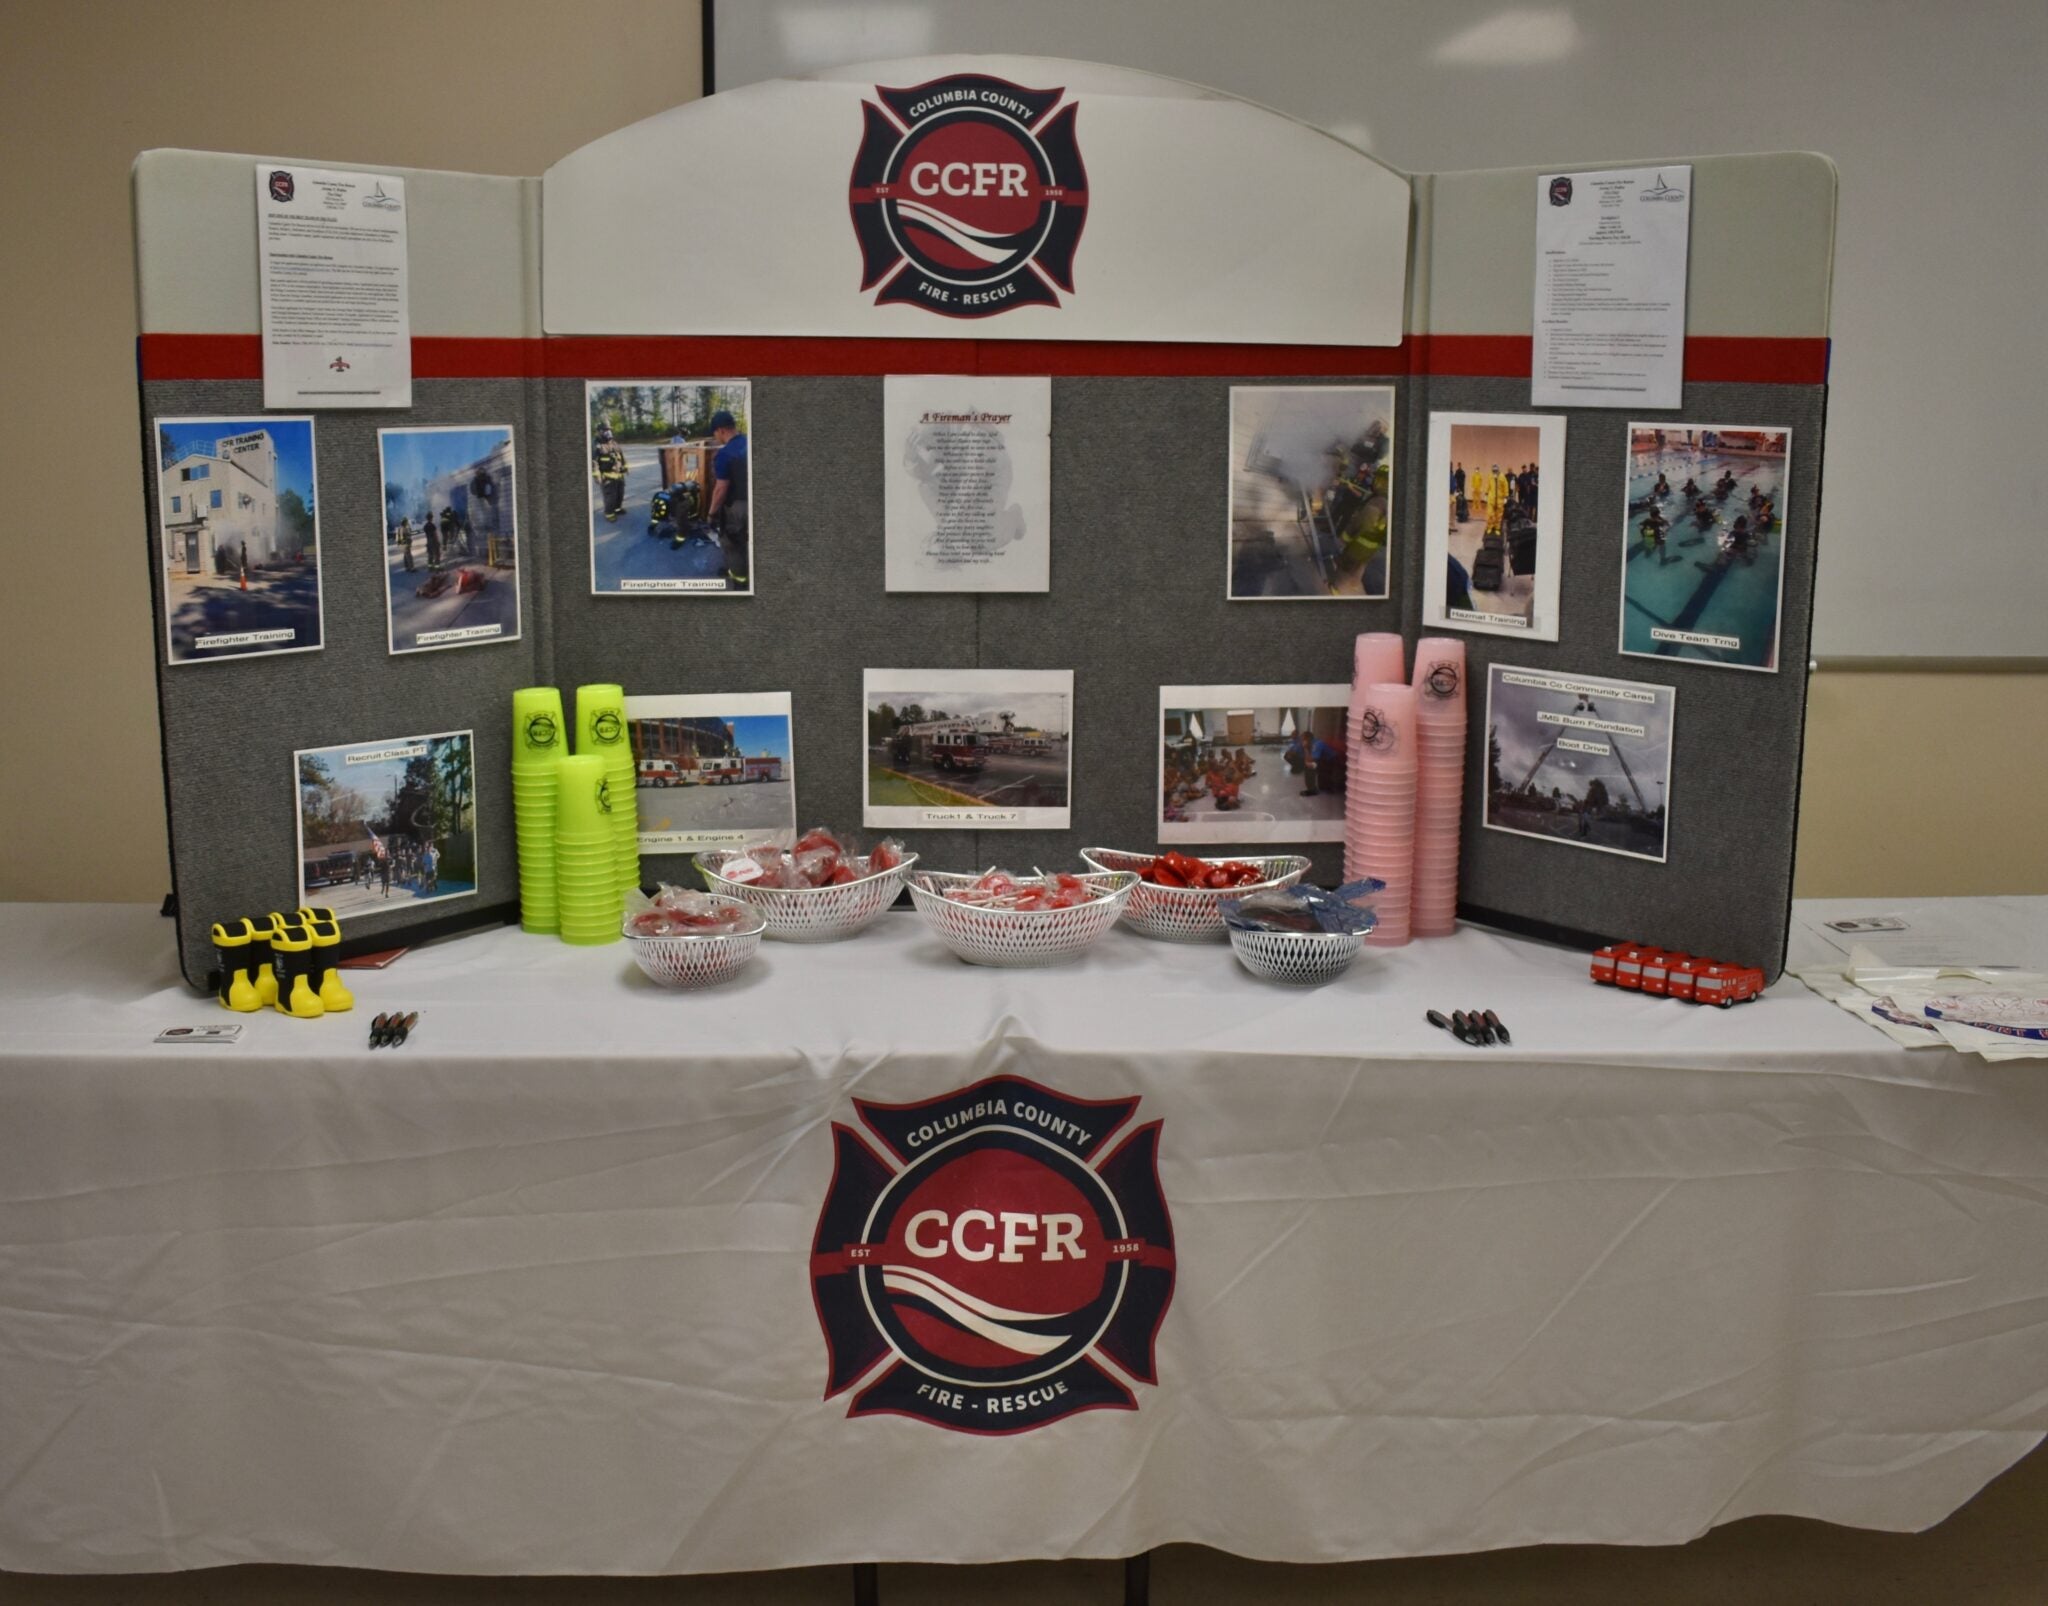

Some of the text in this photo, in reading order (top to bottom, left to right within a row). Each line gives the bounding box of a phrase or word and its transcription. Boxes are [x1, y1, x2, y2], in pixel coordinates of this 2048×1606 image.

[909, 89, 1034, 120] COLUMBIA COUNTY
[909, 162, 1029, 197] CCFR
[918, 281, 949, 302] FIRE
[963, 283, 1016, 305] RESCUE
[920, 411, 1012, 424] A Fireman's Prayer
[235, 432, 264, 445] TRAINING
[622, 581, 724, 589] Firefighter Training
[1452, 612, 1525, 625] Hazmat Training
[196, 630, 293, 646] Firefighter Training
[417, 626, 500, 642] Firefighter Training
[1653, 630, 1739, 647] Dive Team Trng
[1503, 674, 1654, 702] Columbia Co Community Cares
[1539, 713, 1560, 722] JMS
[1588, 721, 1643, 735] Foundation
[1558, 739, 1609, 753] Boot Drive
[348, 751, 382, 762] Recruit
[384, 749, 409, 758] Class
[906, 1099, 1093, 1148] COLUMBIA COUNTY
[904, 1209, 1087, 1263] CCFR
[850, 1243, 1139, 1258] EST 1958
[917, 1383, 964, 1410] FIRE
[986, 1381, 1069, 1414] RESCUE
